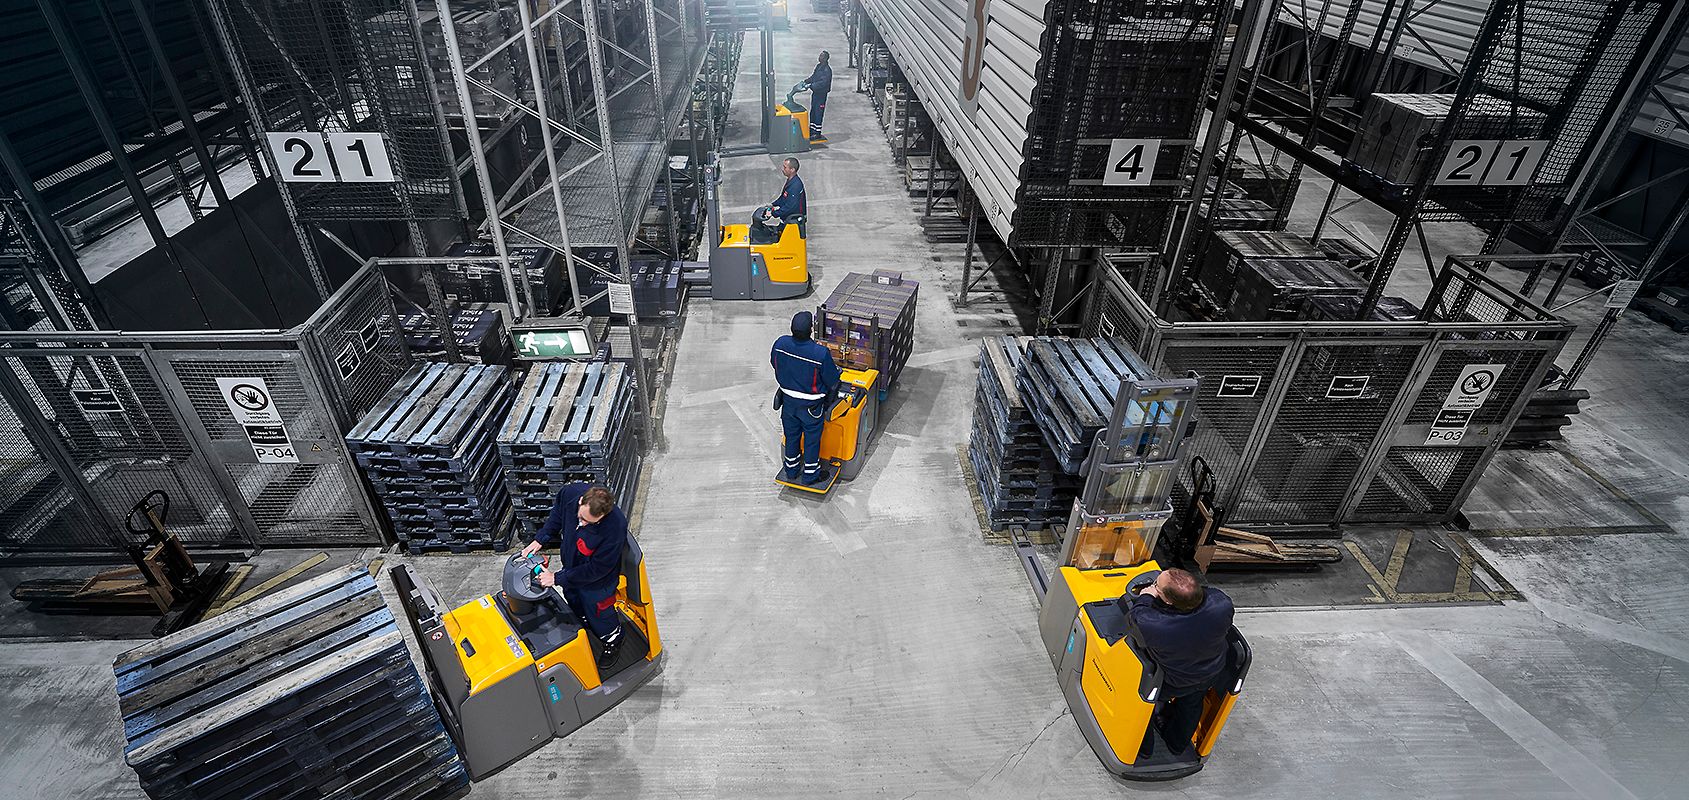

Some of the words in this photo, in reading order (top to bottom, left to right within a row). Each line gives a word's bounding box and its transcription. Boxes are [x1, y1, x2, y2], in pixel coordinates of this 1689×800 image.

[1114, 144, 1146, 181] 4
[1429, 430, 1463, 441] P-03
[257, 448, 295, 458] P-04
